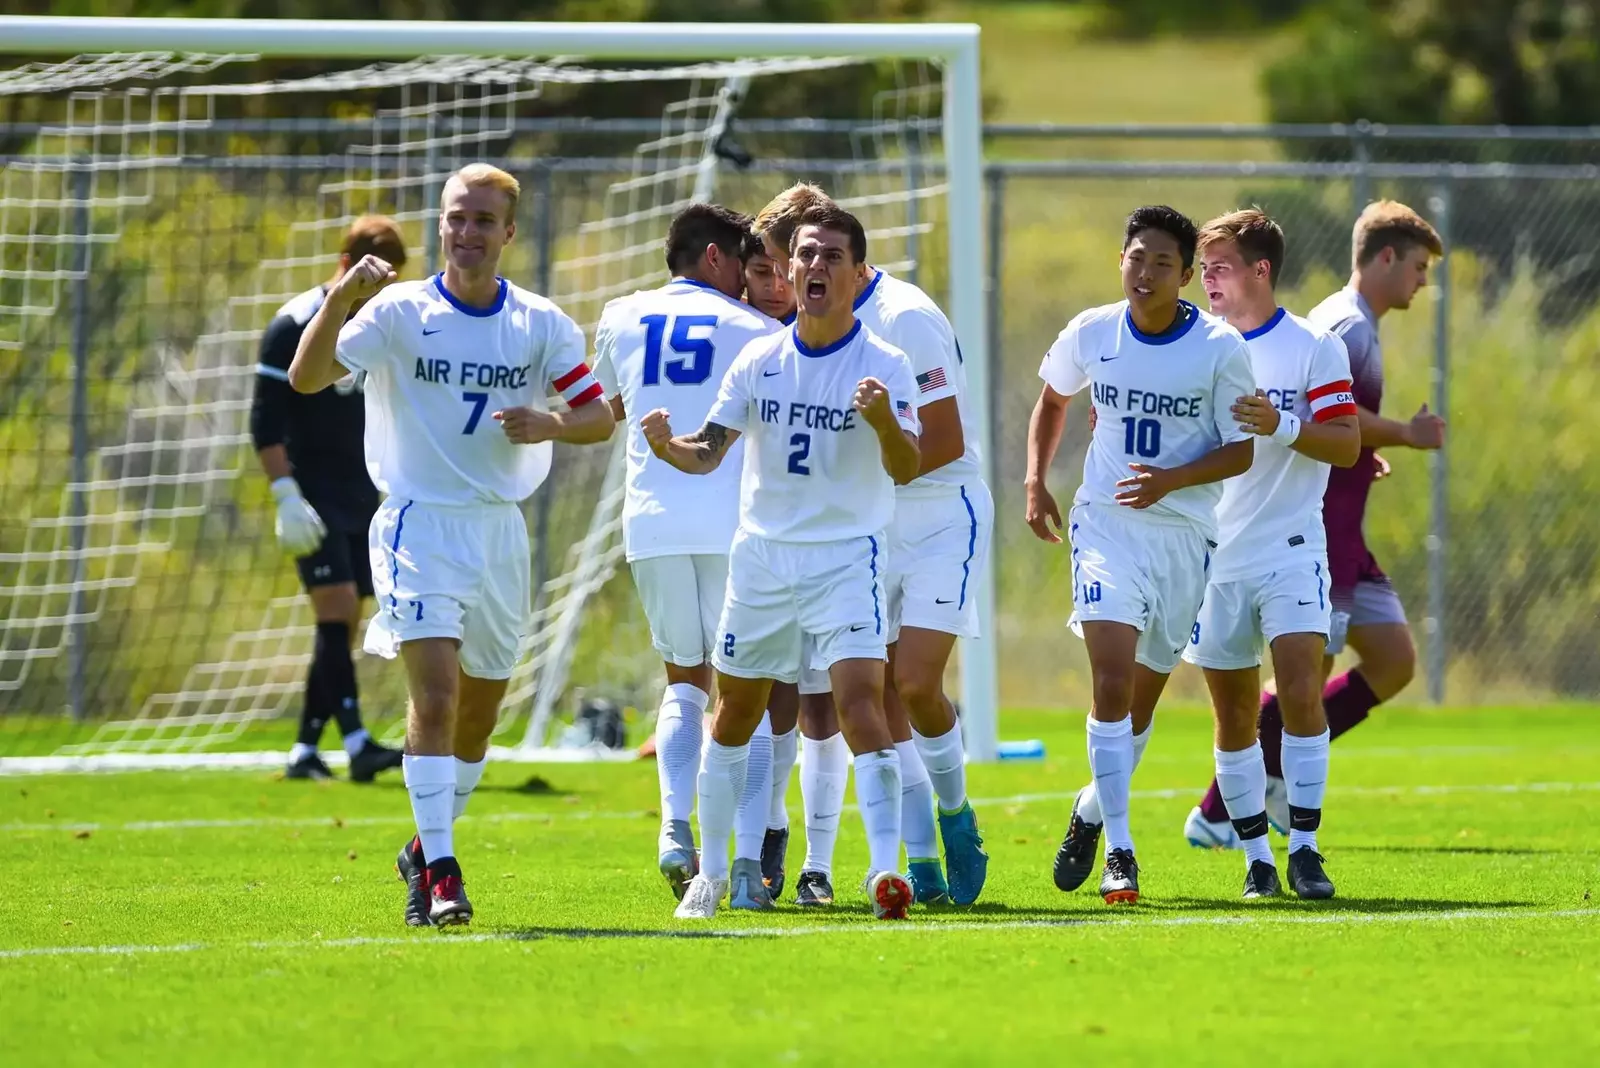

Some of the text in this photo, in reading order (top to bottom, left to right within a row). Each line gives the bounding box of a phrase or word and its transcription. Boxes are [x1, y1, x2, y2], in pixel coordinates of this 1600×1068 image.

[640, 314, 718, 387] 15
[415, 357, 531, 389] AIR FORCE
[462, 392, 488, 435] 7
[754, 398, 857, 432] IR FORCE
[1094, 381, 1202, 418] AIR FORCE
[1267, 388, 1297, 411] CE
[788, 433, 811, 475] 2
[1121, 416, 1161, 458] 10
[1083, 580, 1101, 604] 10
[409, 600, 424, 621] 7
[724, 632, 735, 658] 2
